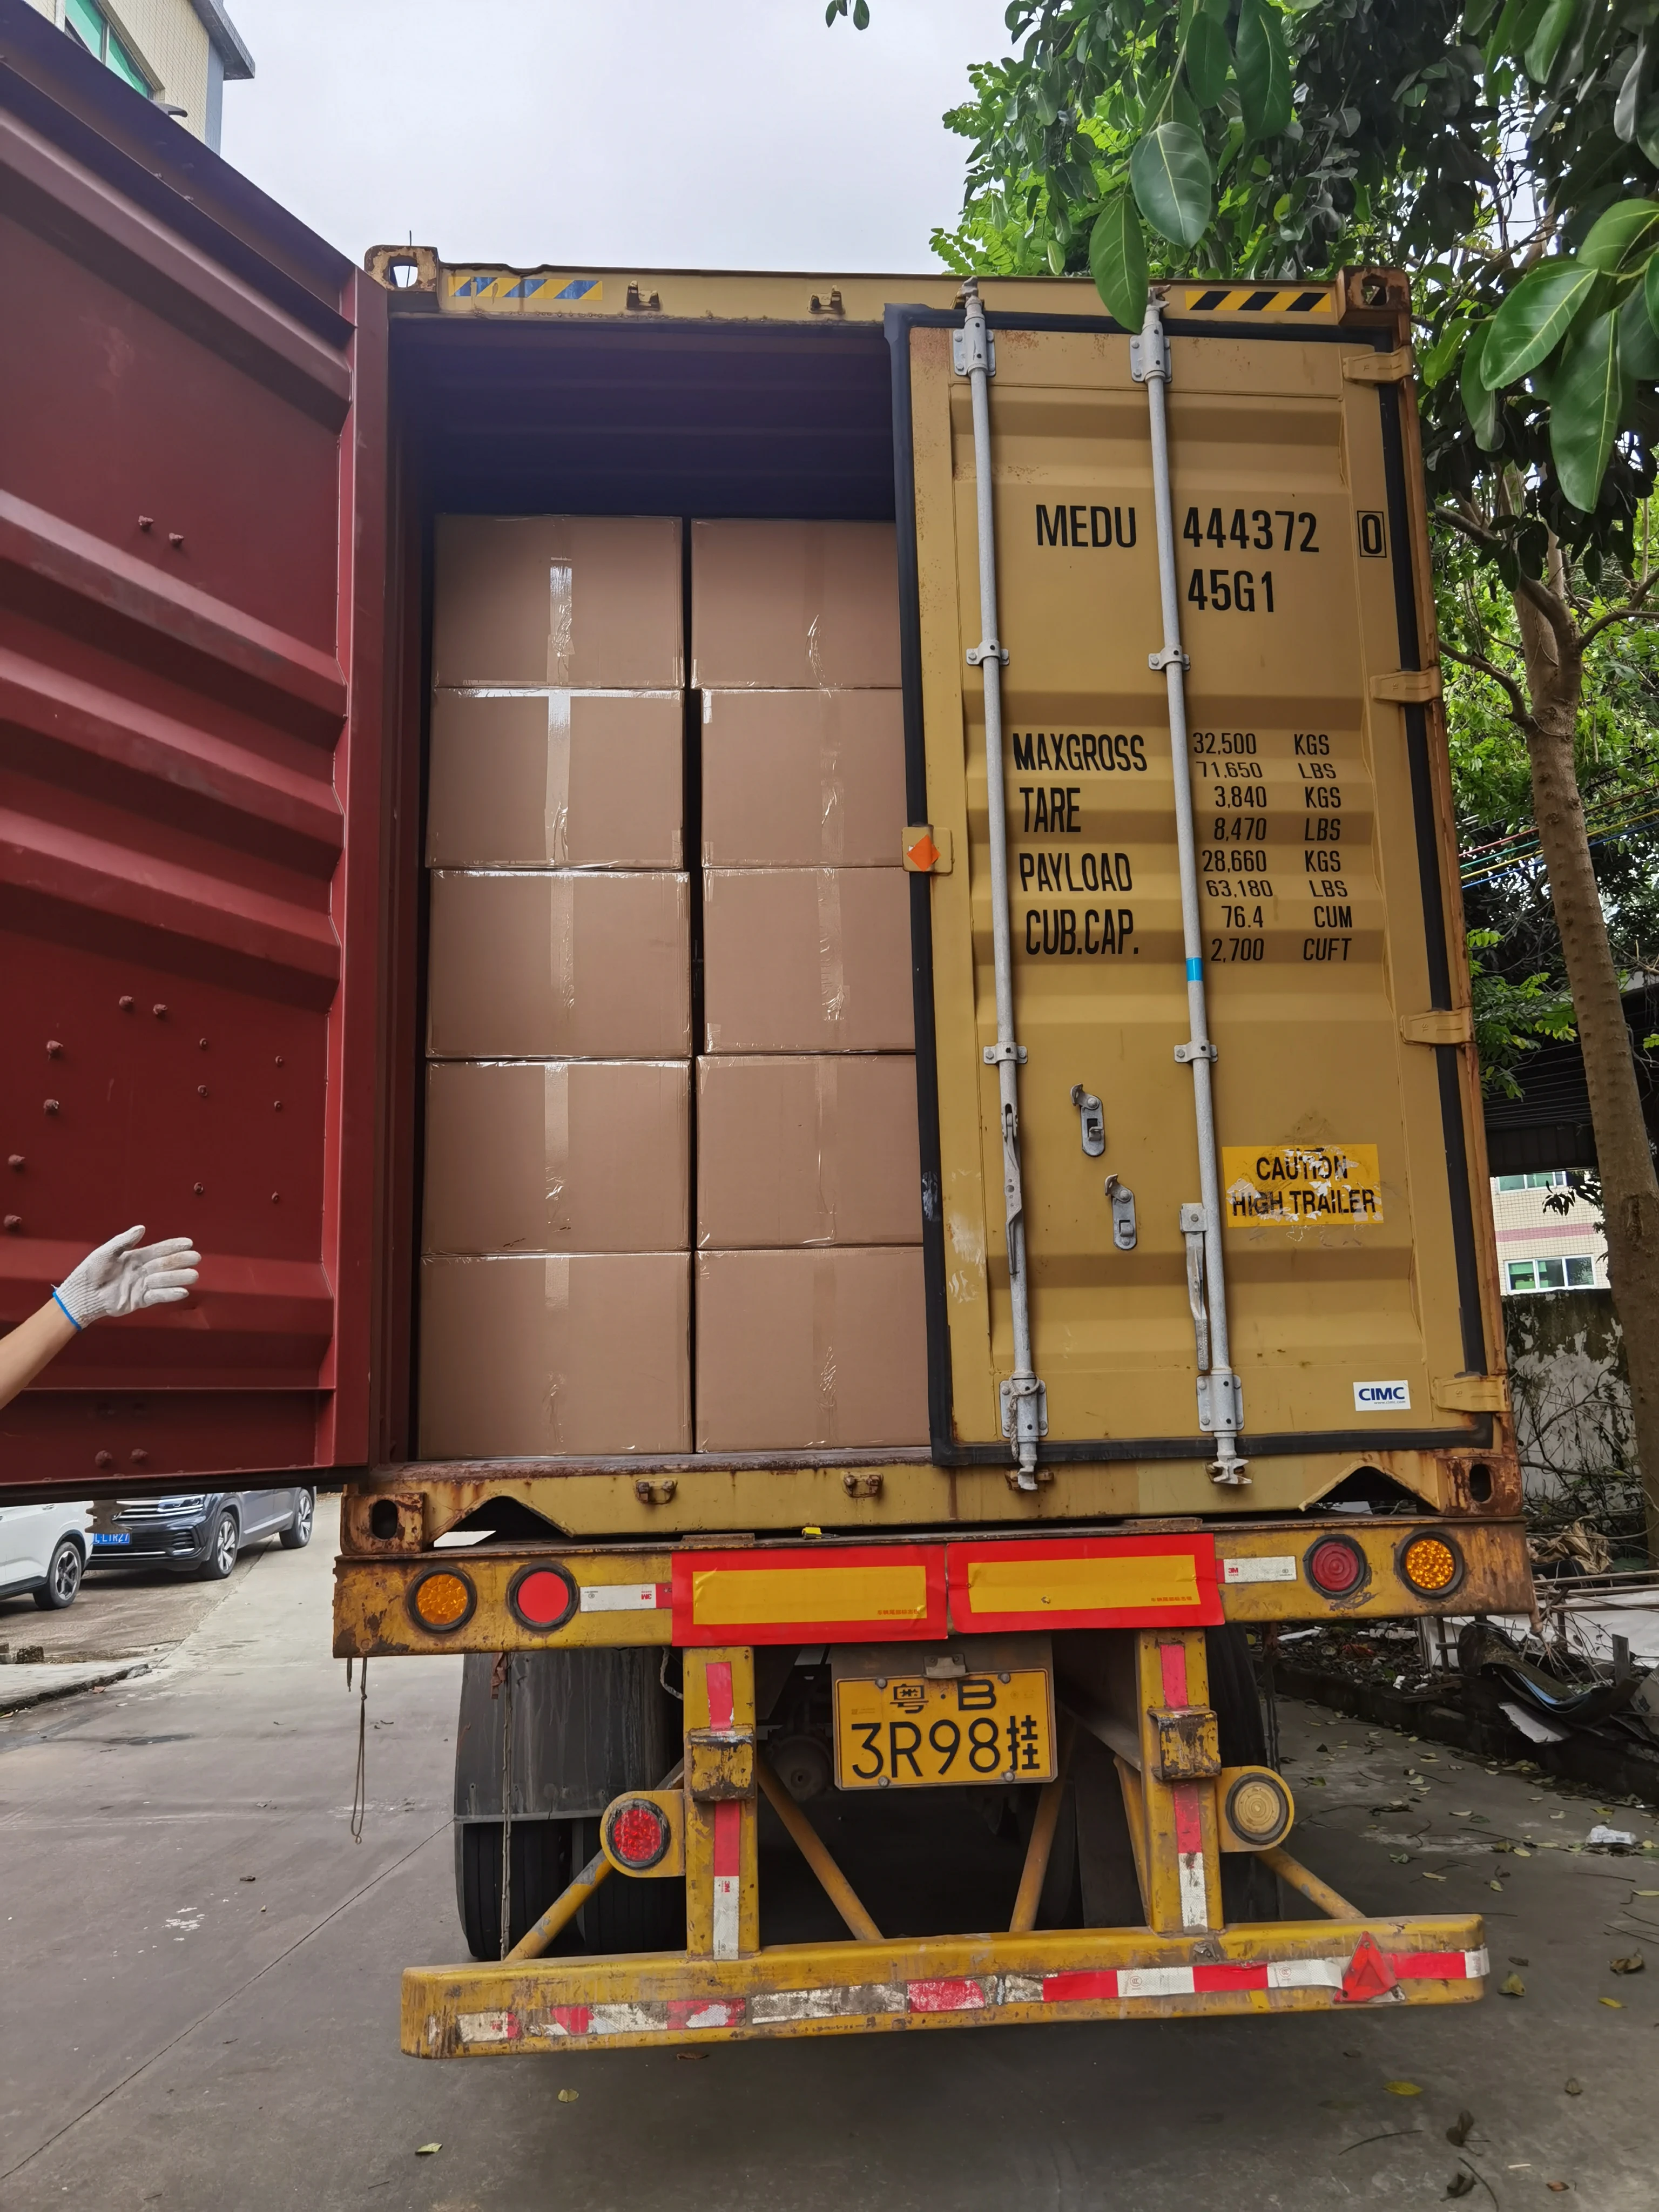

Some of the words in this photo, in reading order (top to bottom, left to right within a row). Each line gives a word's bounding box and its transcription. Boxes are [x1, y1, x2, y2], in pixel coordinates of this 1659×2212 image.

[1036, 504, 1137, 548] MEDU
[1183, 507, 1319, 553] 444372
[1188, 569, 1274, 613] 45G1
[1012, 733, 1148, 772] MAXGROSS
[1192, 732, 1257, 755] 32,500
[1294, 733, 1330, 756] KGS
[1195, 761, 1263, 779] 71,650
[1298, 763, 1337, 779] LBS
[1019, 787, 1081, 833] TARE
[1214, 785, 1267, 808] 3,840
[1305, 786, 1341, 808] KGS
[1214, 817, 1267, 842] 8,470
[1304, 818, 1341, 841] LBS
[1019, 852, 1132, 892] PAYLOAD
[1202, 849, 1267, 873] 28,660
[1304, 850, 1341, 872] KGS
[1205, 880, 1273, 898] 63,180
[1309, 880, 1348, 898] LBS
[1026, 909, 1139, 955] CUB.CAP.
[1221, 905, 1264, 928] 76.4
[1314, 905, 1353, 928] CUM
[1210, 938, 1264, 963] 2,700
[1303, 938, 1352, 961] CUFT
[1256, 1155, 1348, 1181] CAUTION
[1232, 1191, 1283, 1216] HIGH
[1290, 1189, 1377, 1215] TRAILER
[1359, 1387, 1405, 1401] CIMC
[724, 1880, 730, 1892] 3M
